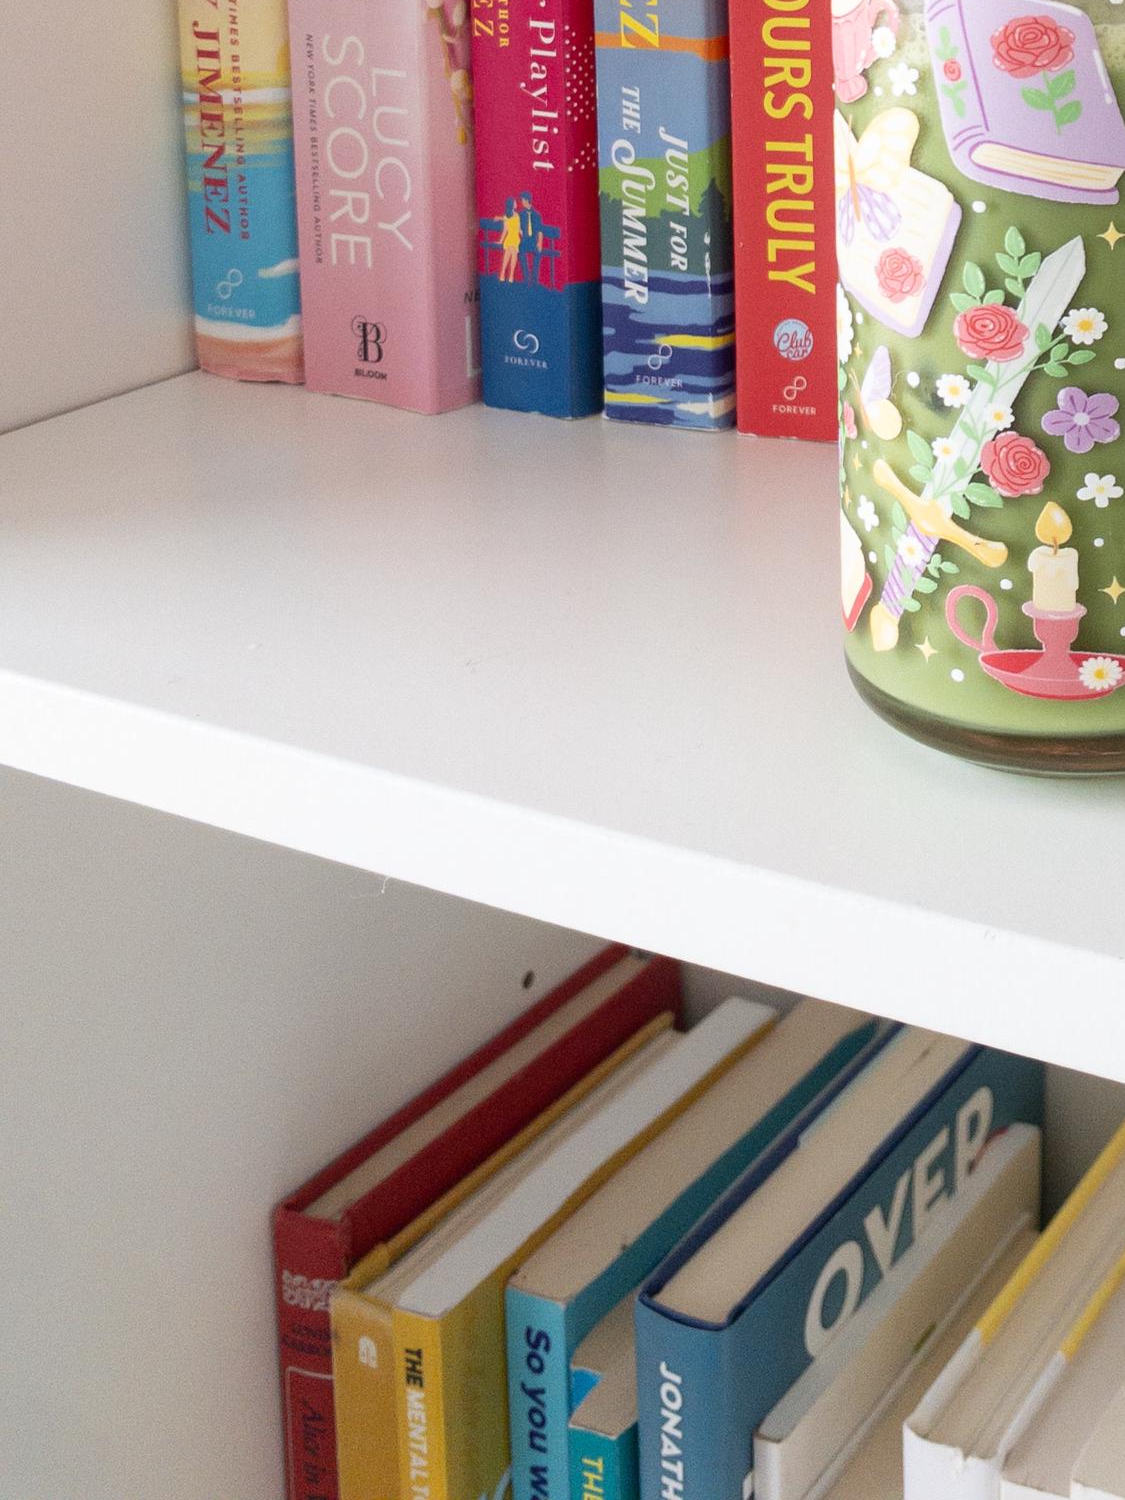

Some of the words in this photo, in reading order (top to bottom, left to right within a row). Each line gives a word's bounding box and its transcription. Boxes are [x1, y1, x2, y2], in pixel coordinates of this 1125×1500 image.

[192, 20, 232, 236] JIMENEZ
[231, 54, 245, 166] BESTSELLING
[519, 16, 559, 172] Playlist
[621, 85, 641, 134] THE
[322, 33, 374, 270] SCORE
[371, 66, 413, 252] LUCY
[658, 125, 689, 218] JUST
[237, 174, 251, 241] AUTHOR
[611, 138, 656, 305] SUMMER
[668, 221, 689, 271] FOR
[764, 133, 816, 295] TRULY
[207, 303, 256, 319] FOREVER
[504, 355, 548, 370] FOREVER
[635, 375, 683, 389] FOREVER
[772, 404, 817, 416] FOREVER
[404, 1348, 424, 1388] THE
[524, 1325, 552, 1375] So
[406, 1390, 431, 1481] MENTAL
[520, 1381, 548, 1454] you
[660, 1361, 684, 1500] JONATH
